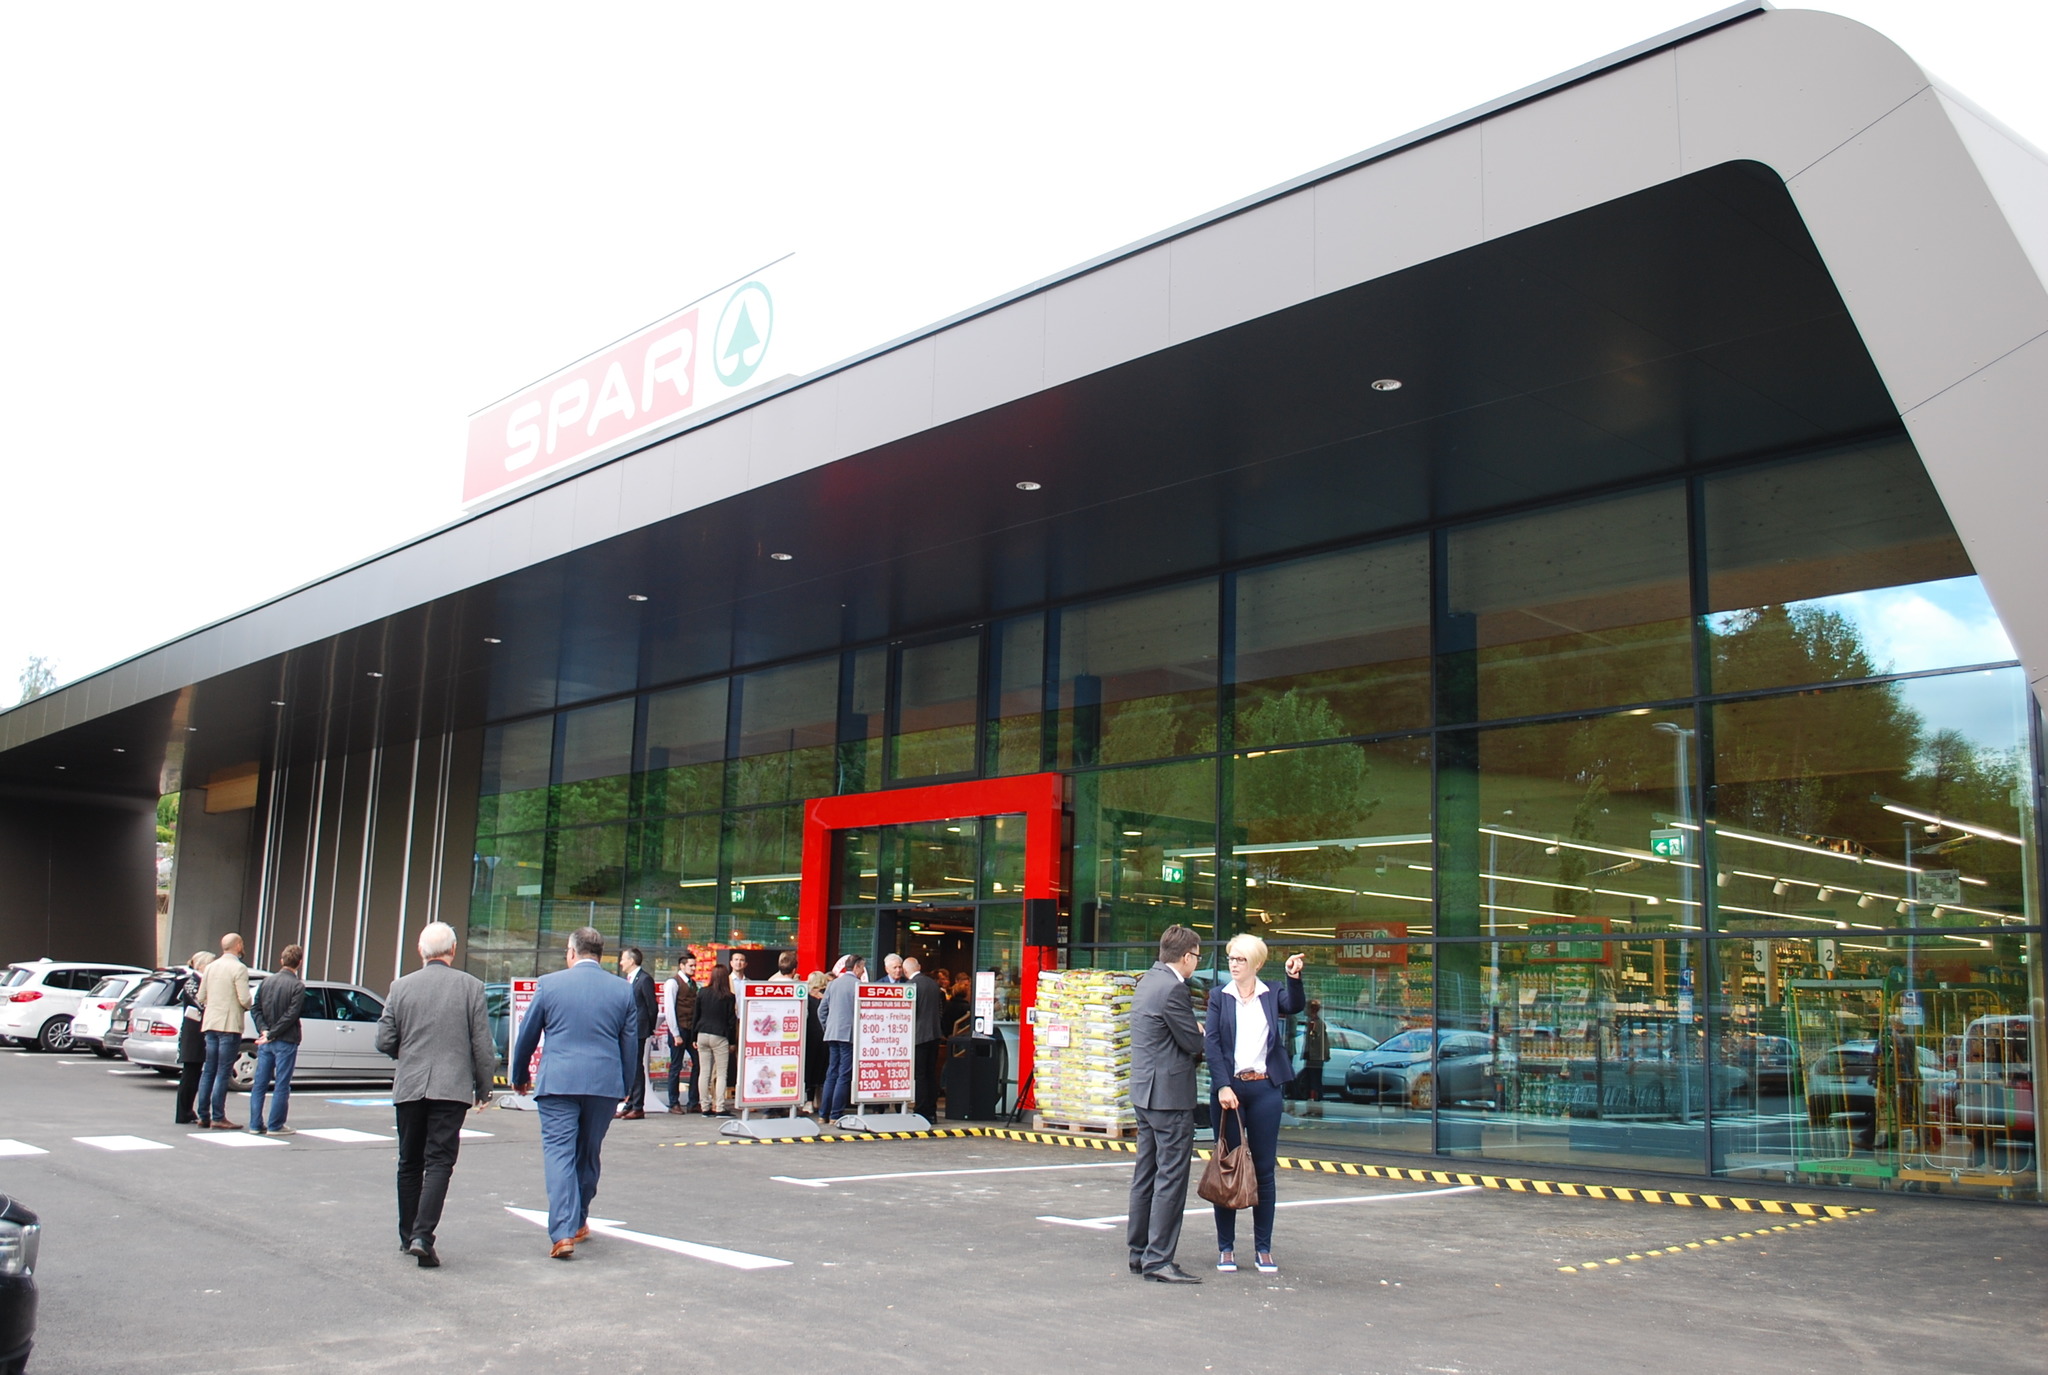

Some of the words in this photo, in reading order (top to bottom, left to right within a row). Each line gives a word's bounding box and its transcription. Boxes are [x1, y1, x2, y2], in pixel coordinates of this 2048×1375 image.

[504, 327, 694, 473] SPAR
[1343, 944, 1374, 958] NEU
[1375, 950, 1391, 958] da!
[1755, 949, 1762, 962] 3
[1826, 949, 1833, 961] 2
[754, 986, 794, 996] SPAR
[867, 987, 903, 997] SPAR
[860, 1013, 884, 1022] Montag
[890, 1013, 911, 1022] Freitag
[863, 1024, 880, 1033] 8:00
[888, 1024, 908, 1033] 18:50
[872, 1036, 899, 1045] Samstag
[745, 1046, 800, 1056] BILLIGER!
[862, 1047, 879, 1057] 8:00
[888, 1047, 908, 1056] 17:50
[884, 1061, 910, 1069] Feiertage
[861, 1069, 879, 1079] 8:00
[887, 1069, 908, 1078] 13:00
[859, 1080, 881, 1089] 15:00
[889, 1080, 910, 1089] 18:00
